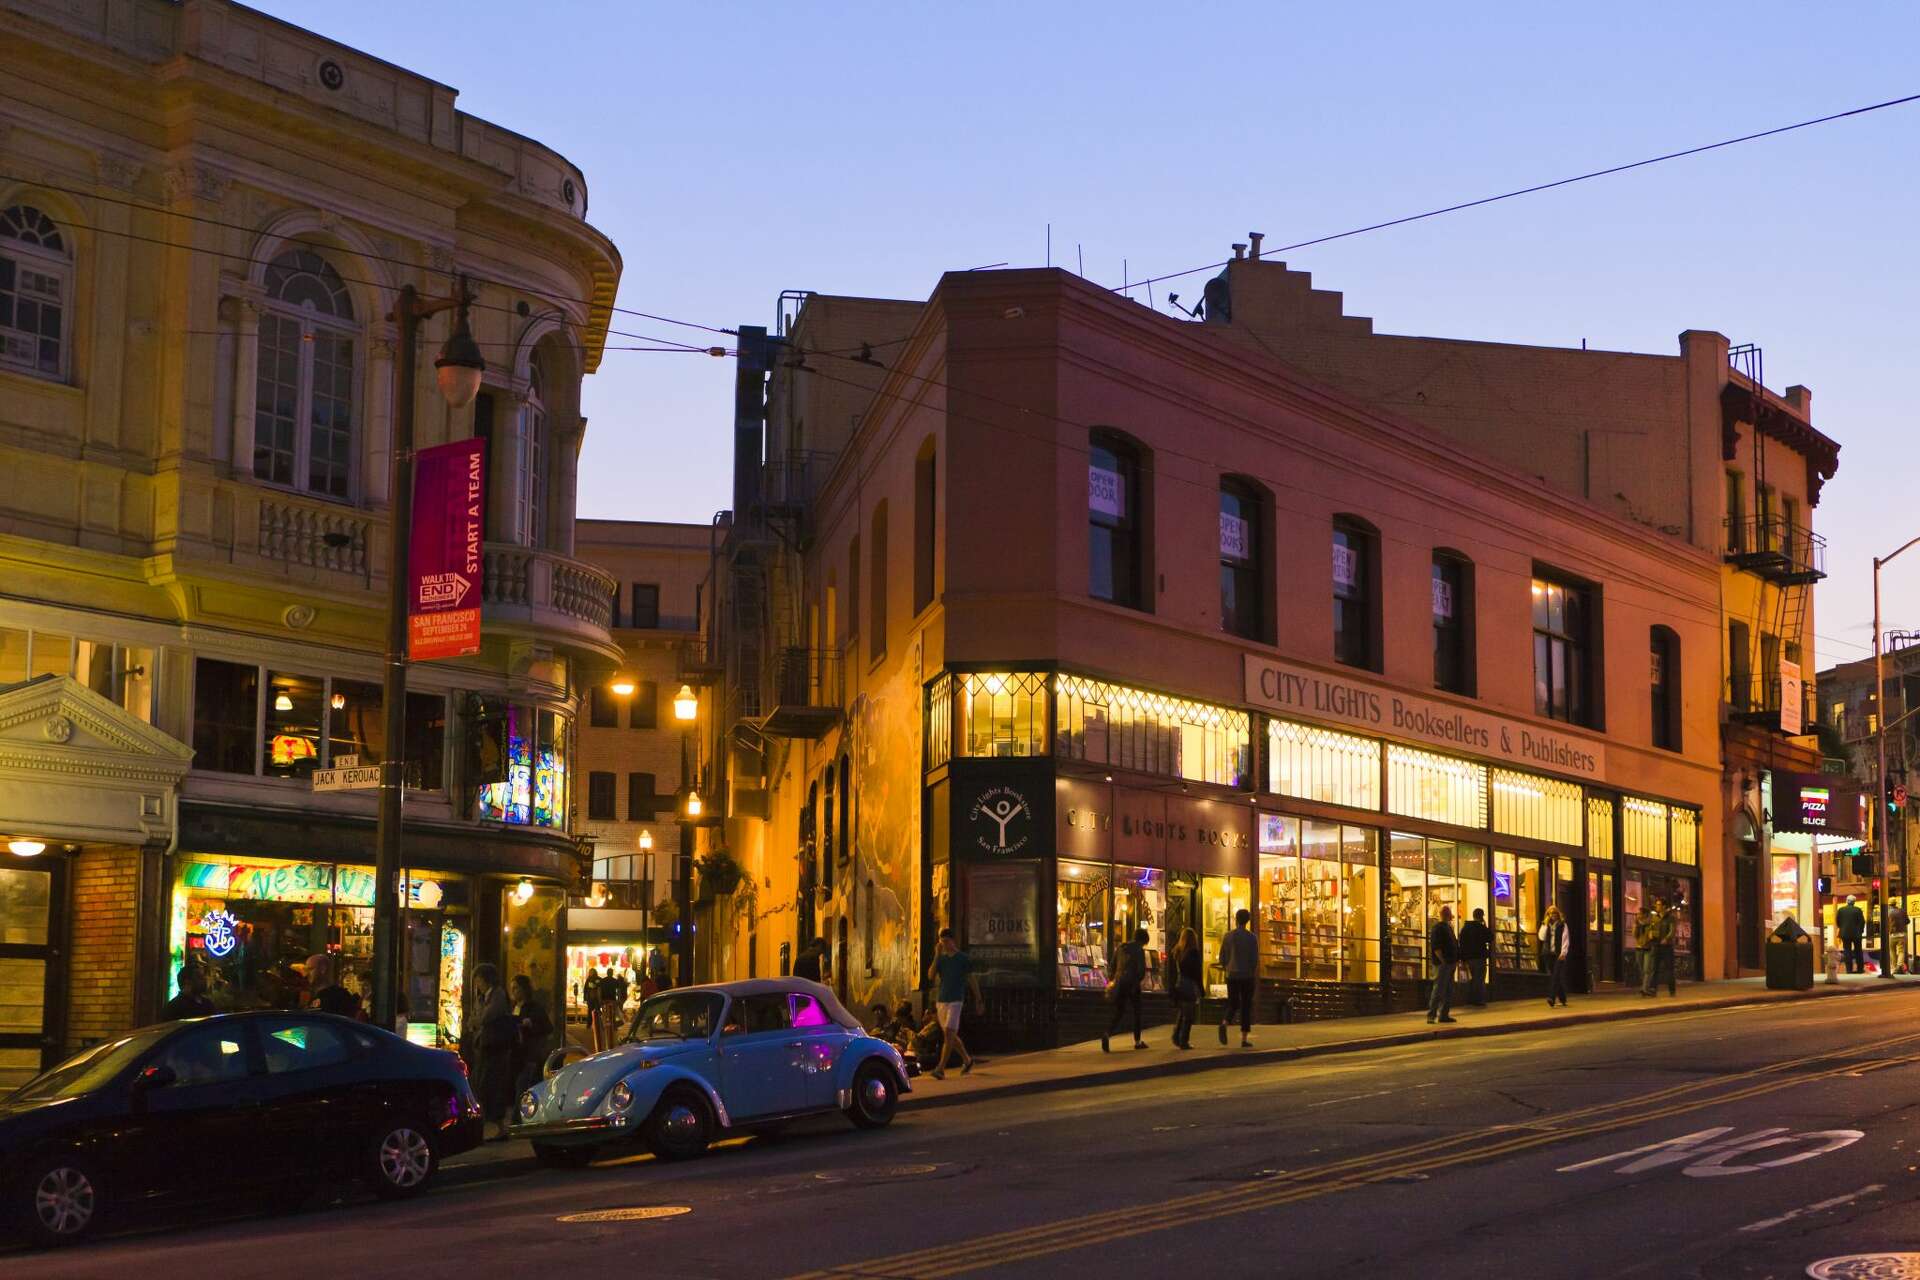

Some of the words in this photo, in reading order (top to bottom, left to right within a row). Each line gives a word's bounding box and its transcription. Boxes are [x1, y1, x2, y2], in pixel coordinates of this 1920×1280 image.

[469, 453, 481, 501] TEAM
[468, 505, 479, 517] A
[466, 523, 479, 574] START
[422, 574, 445, 585] WALK
[445, 572, 455, 582] TO
[421, 584, 454, 597] END
[414, 615, 431, 627] SAN
[432, 610, 475, 624] FRANCISCO
[422, 625, 460, 636] SEPTEMBER
[1260, 667, 1308, 706] CITY
[1313, 680, 1382, 724] LIGHTS
[1393, 699, 1489, 748] Booksellers
[1500, 725, 1512, 754] &
[1521, 731, 1596, 772] Publishers
[338, 757, 354, 766] END
[315, 772, 336, 786] JACK
[342, 769, 380, 784] KEROUAC
[1802, 802, 1826, 811] PIZZA
[1802, 817, 1826, 826] SLICE
[1123, 816, 1186, 841] LIGHTS
[1198, 829, 1249, 849] BOOKS
[201, 909, 238, 929] STEAM
